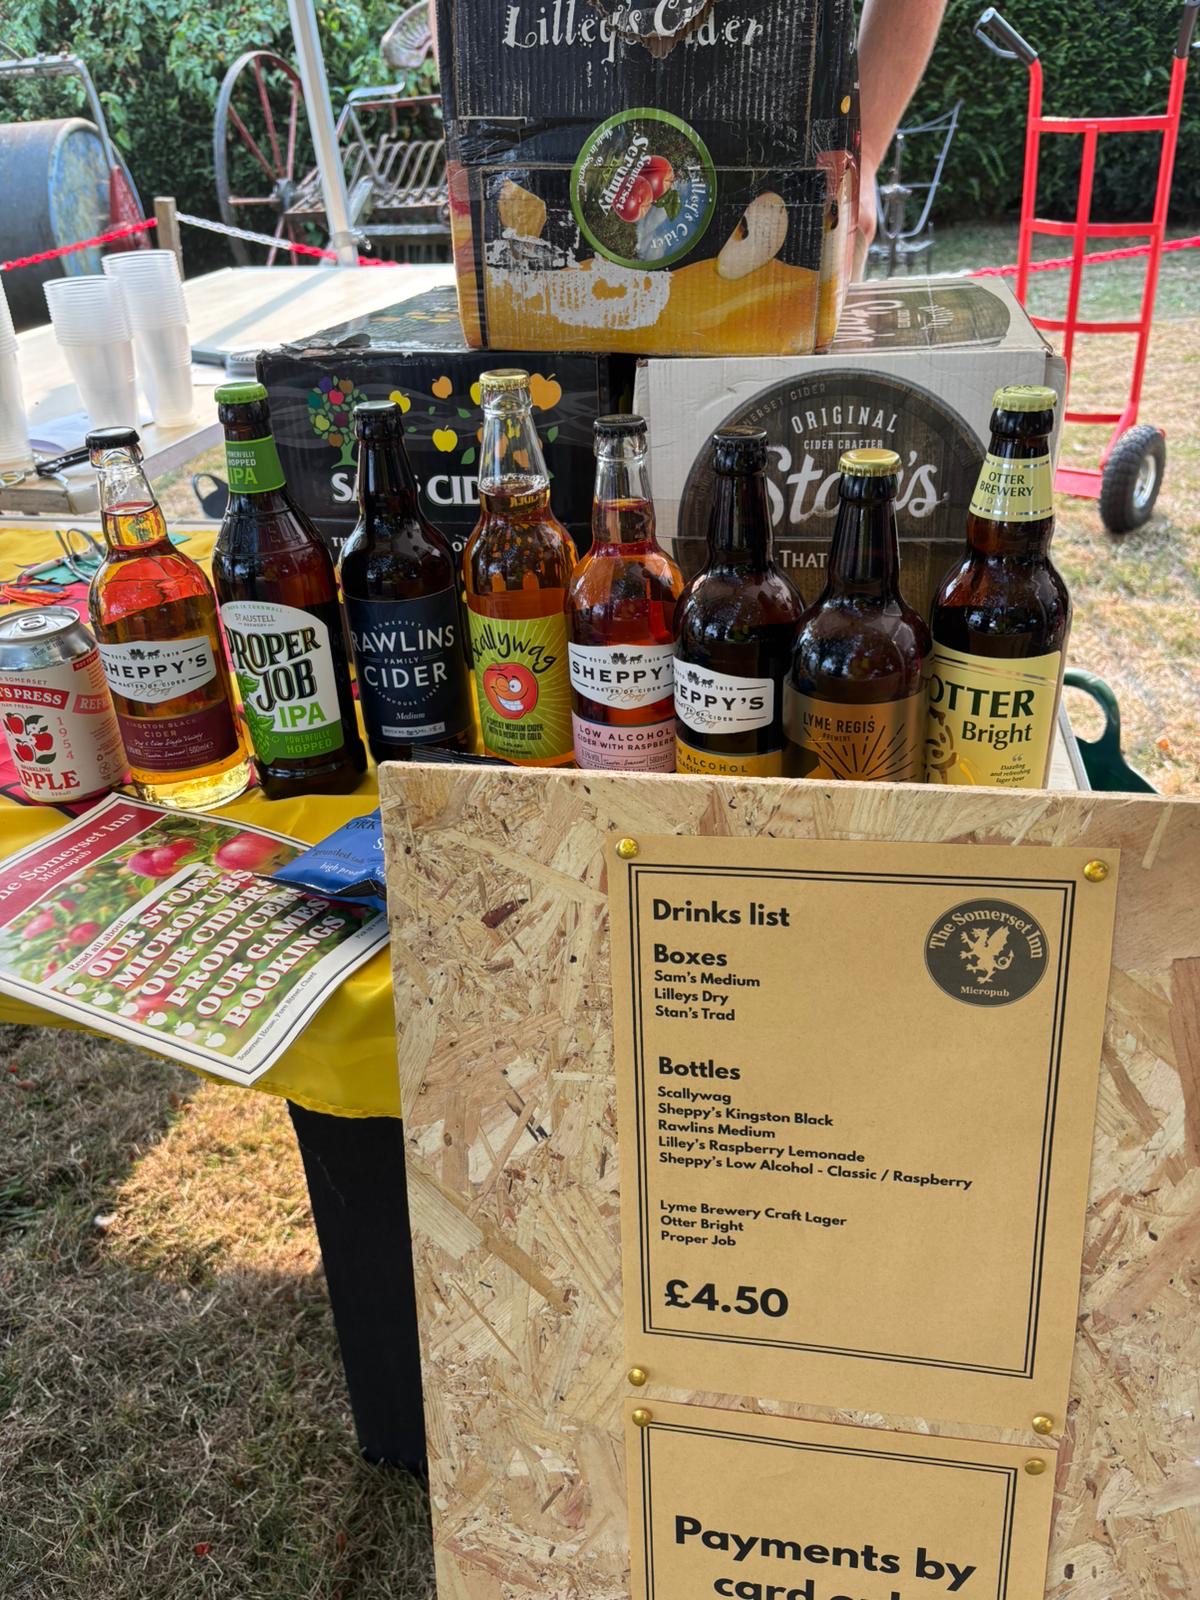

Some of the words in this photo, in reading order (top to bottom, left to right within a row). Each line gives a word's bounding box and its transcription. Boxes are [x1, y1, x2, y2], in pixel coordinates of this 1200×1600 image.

[502, 0, 641, 63] Lilley's
[654, 0, 763, 46] Cider
[599, 132, 649, 216] Scrumpy
[615, 151, 652, 211] Somerset
[685, 164, 706, 222] Lilley's
[650, 223, 688, 249] Cider
[790, 383, 827, 401] CIDER
[791, 405, 898, 435] ORIGINAL
[804, 439, 834, 450] CIDER
[838, 438, 884, 450] CRAFTER
[229, 467, 258, 485] IPA
[766, 445, 944, 527] Sta's
[989, 471, 1025, 485] OTTER
[980, 481, 1034, 497] BREWERY
[779, 550, 828, 568] THAT
[242, 613, 276, 623] AUSTELL
[225, 626, 322, 676] PROPER
[351, 625, 455, 653] RAWLINS
[102, 653, 208, 679] SHEPPY'S
[384, 656, 420, 665] FAMILY
[572, 661, 675, 684] SHEPPY'
[162, 679, 186, 687] CIDER
[256, 658, 318, 712] JOB
[363, 662, 448, 689] CIDER
[14, 687, 63, 705] PRESS
[590, 685, 618, 694] MASTER
[638, 685, 661, 693] CIDER
[929, 674, 1035, 718] OTTER
[278, 702, 327, 729] IPA
[395, 711, 426, 720] Medium
[527, 723, 544, 731] CIDER
[708, 714, 733, 722] CIDER
[803, 711, 831, 731] LYME
[837, 719, 876, 733] REGIS
[144, 730, 177, 739] CIDER
[284, 731, 331, 745] POWERFULLY
[287, 738, 332, 753] HOPPED
[577, 733, 597, 746] CIDER
[599, 741, 624, 750] WITH
[628, 736, 675, 751] RASPBERR
[579, 725, 602, 738] LOW
[608, 727, 672, 742] ALCOHOL
[961, 720, 1032, 751] Bright
[687, 754, 748, 773] ALCOHOL
[19, 831, 107, 881] Somerset
[101, 813, 136, 832] Inn
[37, 850, 92, 882] Micropub
[87, 928, 147, 978] OUR
[138, 867, 221, 930] STORY
[652, 898, 741, 925] Drinks
[749, 902, 791, 927] list
[111, 869, 255, 990] MICROPUBS
[139, 944, 198, 996] OUR
[191, 878, 277, 944] CIDERS
[929, 923, 956, 949] The
[952, 910, 1033, 935] Somerset
[1026, 930, 1043, 959] Inn
[165, 887, 305, 1008] PRODUCERS
[196, 961, 255, 1018] OUR
[246, 898, 331, 961] GAMES
[654, 943, 728, 966] Boxes
[68, 948, 93, 973] Read
[221, 915, 346, 1029] BOOKINGS
[654, 970, 697, 984] Sam's
[700, 972, 761, 987] Medium
[654, 988, 699, 1004] Lilleys
[702, 990, 729, 1006] Dry
[960, 986, 1010, 997] Micropub
[655, 1005, 700, 1019] Stan's
[701, 1008, 736, 1021] Trad
[658, 1056, 741, 1080] Bottles
[657, 1086, 732, 1105] Scallywag
[658, 1102, 722, 1120] Sheppy's
[725, 1108, 791, 1124] Kingston
[794, 1112, 833, 1127] Black
[658, 1119, 714, 1135] Rawlins
[717, 1124, 776, 1139] Medium
[658, 1136, 706, 1152] Lilley's
[709, 1140, 784, 1158] Raspberry
[788, 1145, 865, 1163] Lemonade
[659, 1152, 722, 1170] Sheppy's
[726, 1156, 756, 1170] Low
[760, 1158, 814, 1175] Alcohol
[827, 1165, 877, 1180] Classic
[881, 1169, 889, 1182] /
[893, 1171, 973, 1191] Raspberry
[660, 1200, 697, 1215] Lyme
[700, 1203, 761, 1220] Brewery
[764, 1207, 801, 1222] Craft
[805, 1212, 847, 1228] Lager
[660, 1215, 697, 1229] Otter
[700, 1218, 744, 1233] Bright
[661, 1231, 708, 1247] Proper
[711, 1234, 736, 1247] Job
[664, 1278, 789, 1318] £4.50
[674, 1515, 901, 1574] Payments
[916, 1547, 977, 1592] by
[714, 1574, 815, 1600] card
